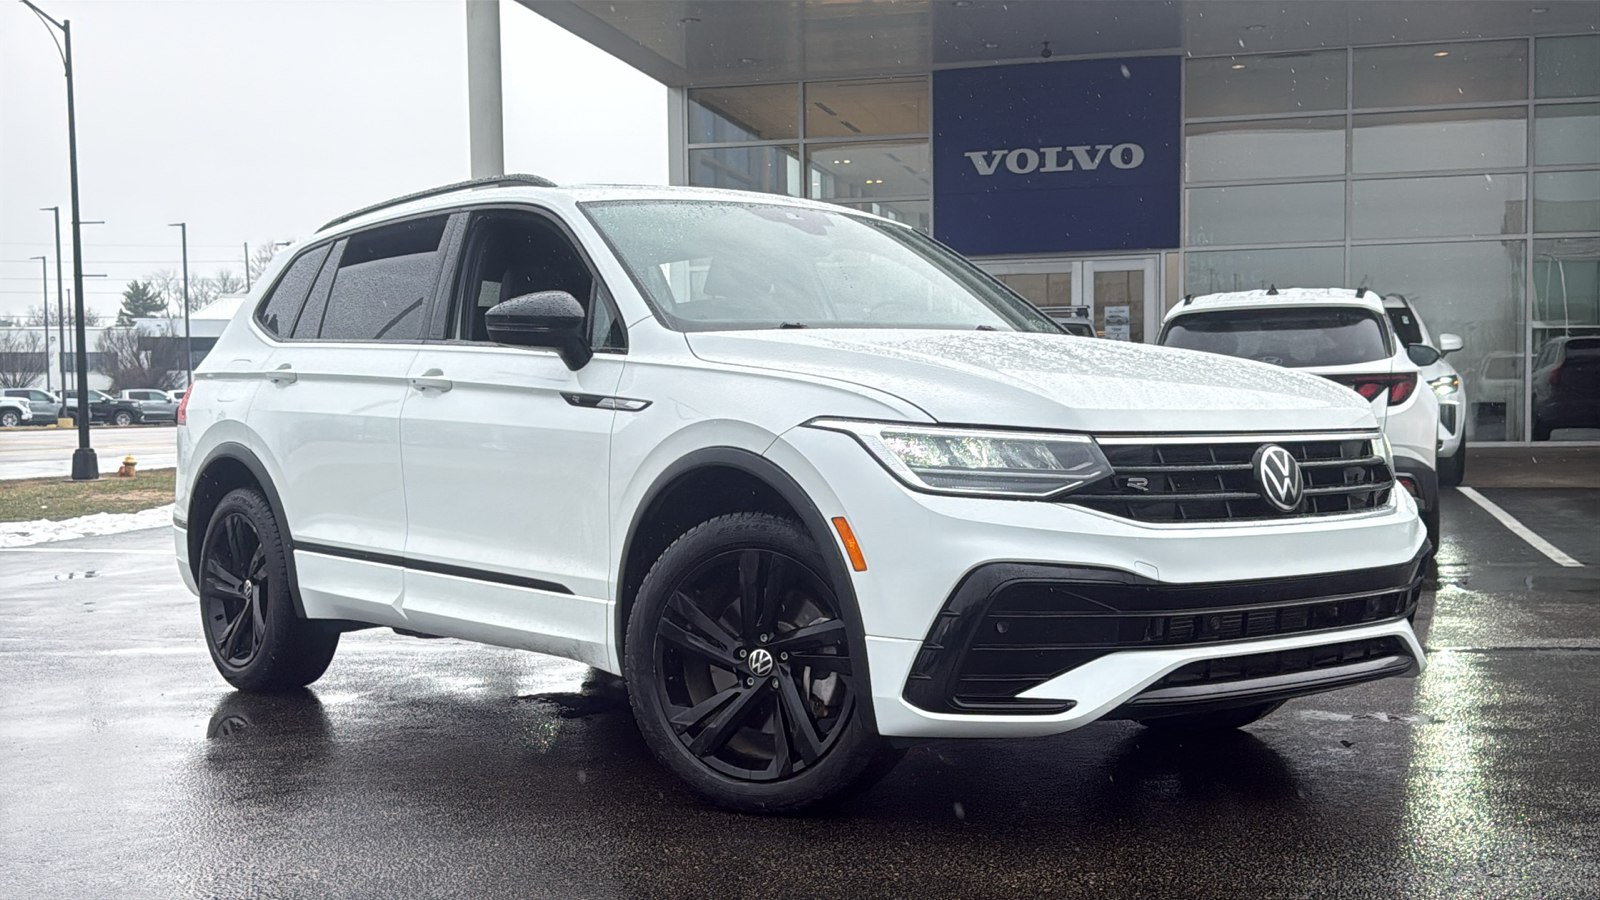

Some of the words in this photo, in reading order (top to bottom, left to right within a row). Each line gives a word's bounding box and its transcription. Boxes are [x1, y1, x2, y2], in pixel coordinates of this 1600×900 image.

[964, 142, 1145, 176] VOLVO
[1126, 477, 1149, 492] R
[1261, 446, 1302, 508] VW
[749, 649, 773, 676] VW
